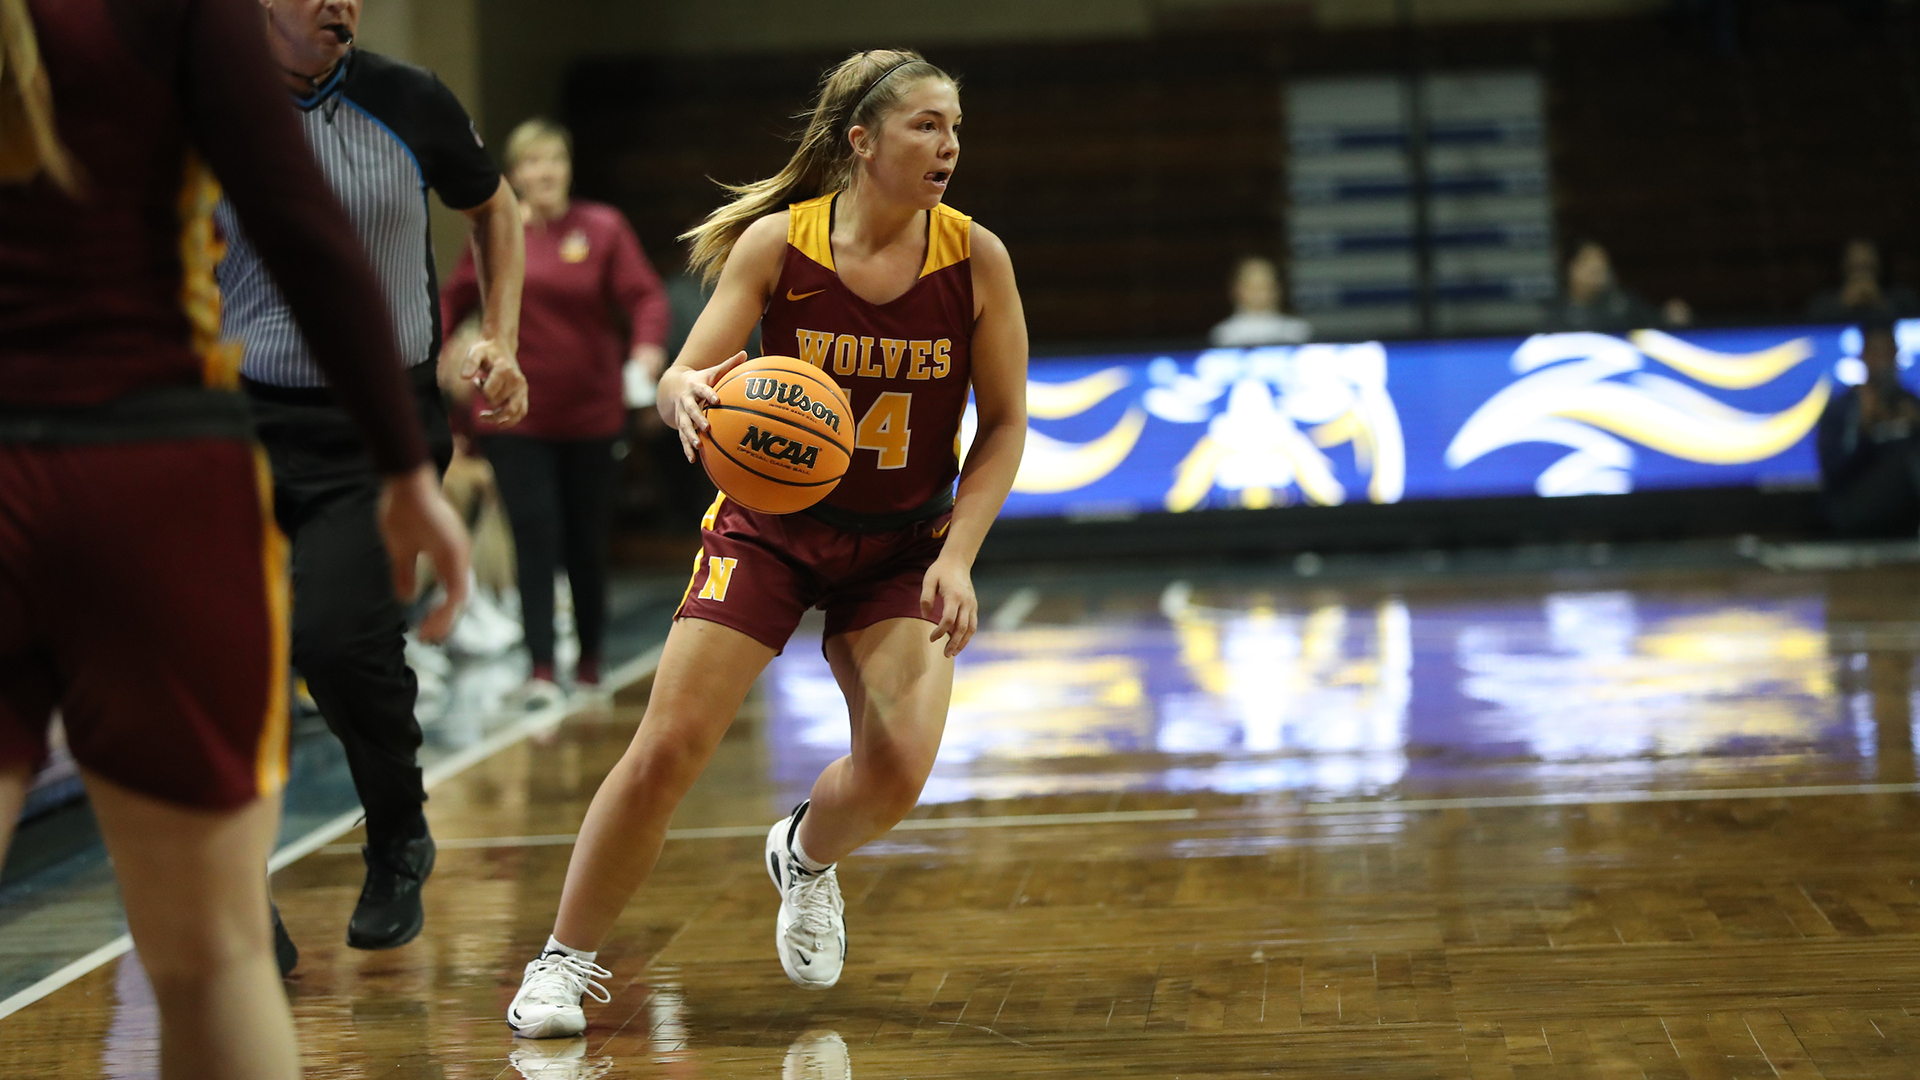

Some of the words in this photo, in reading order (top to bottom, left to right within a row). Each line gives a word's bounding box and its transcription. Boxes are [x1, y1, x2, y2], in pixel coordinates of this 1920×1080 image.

[796, 328, 952, 380] WOLVES
[745, 377, 841, 433] Wilson
[790, 409, 805, 417] GAME
[806, 415, 818, 423] BALL
[739, 424, 819, 470] NCAA
[841, 388, 913, 470] 4
[737, 447, 768, 463] OFFICIAL
[769, 459, 791, 471] GAME
[792, 467, 811, 475] BALL
[697, 556, 739, 602] N
